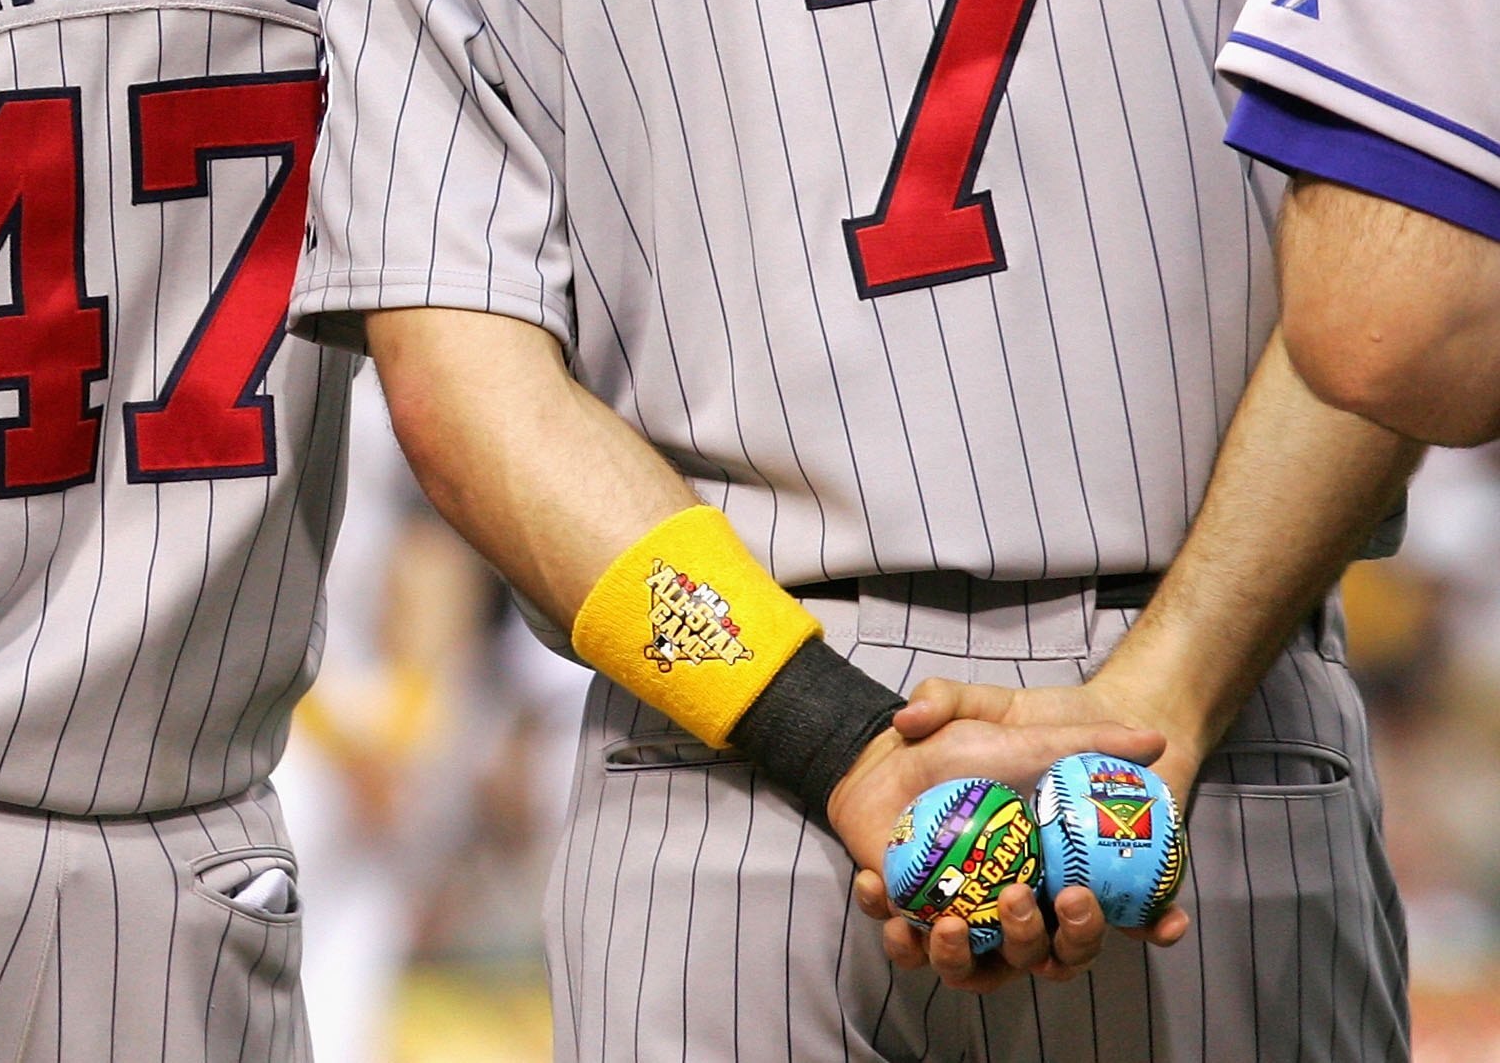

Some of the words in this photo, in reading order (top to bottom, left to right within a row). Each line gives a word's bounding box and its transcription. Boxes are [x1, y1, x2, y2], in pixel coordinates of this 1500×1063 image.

[692, 582, 730, 618] MLB
[649, 602, 710, 665] GAME
[962, 848, 985, 874] 06
[981, 812, 1033, 884] GAME
